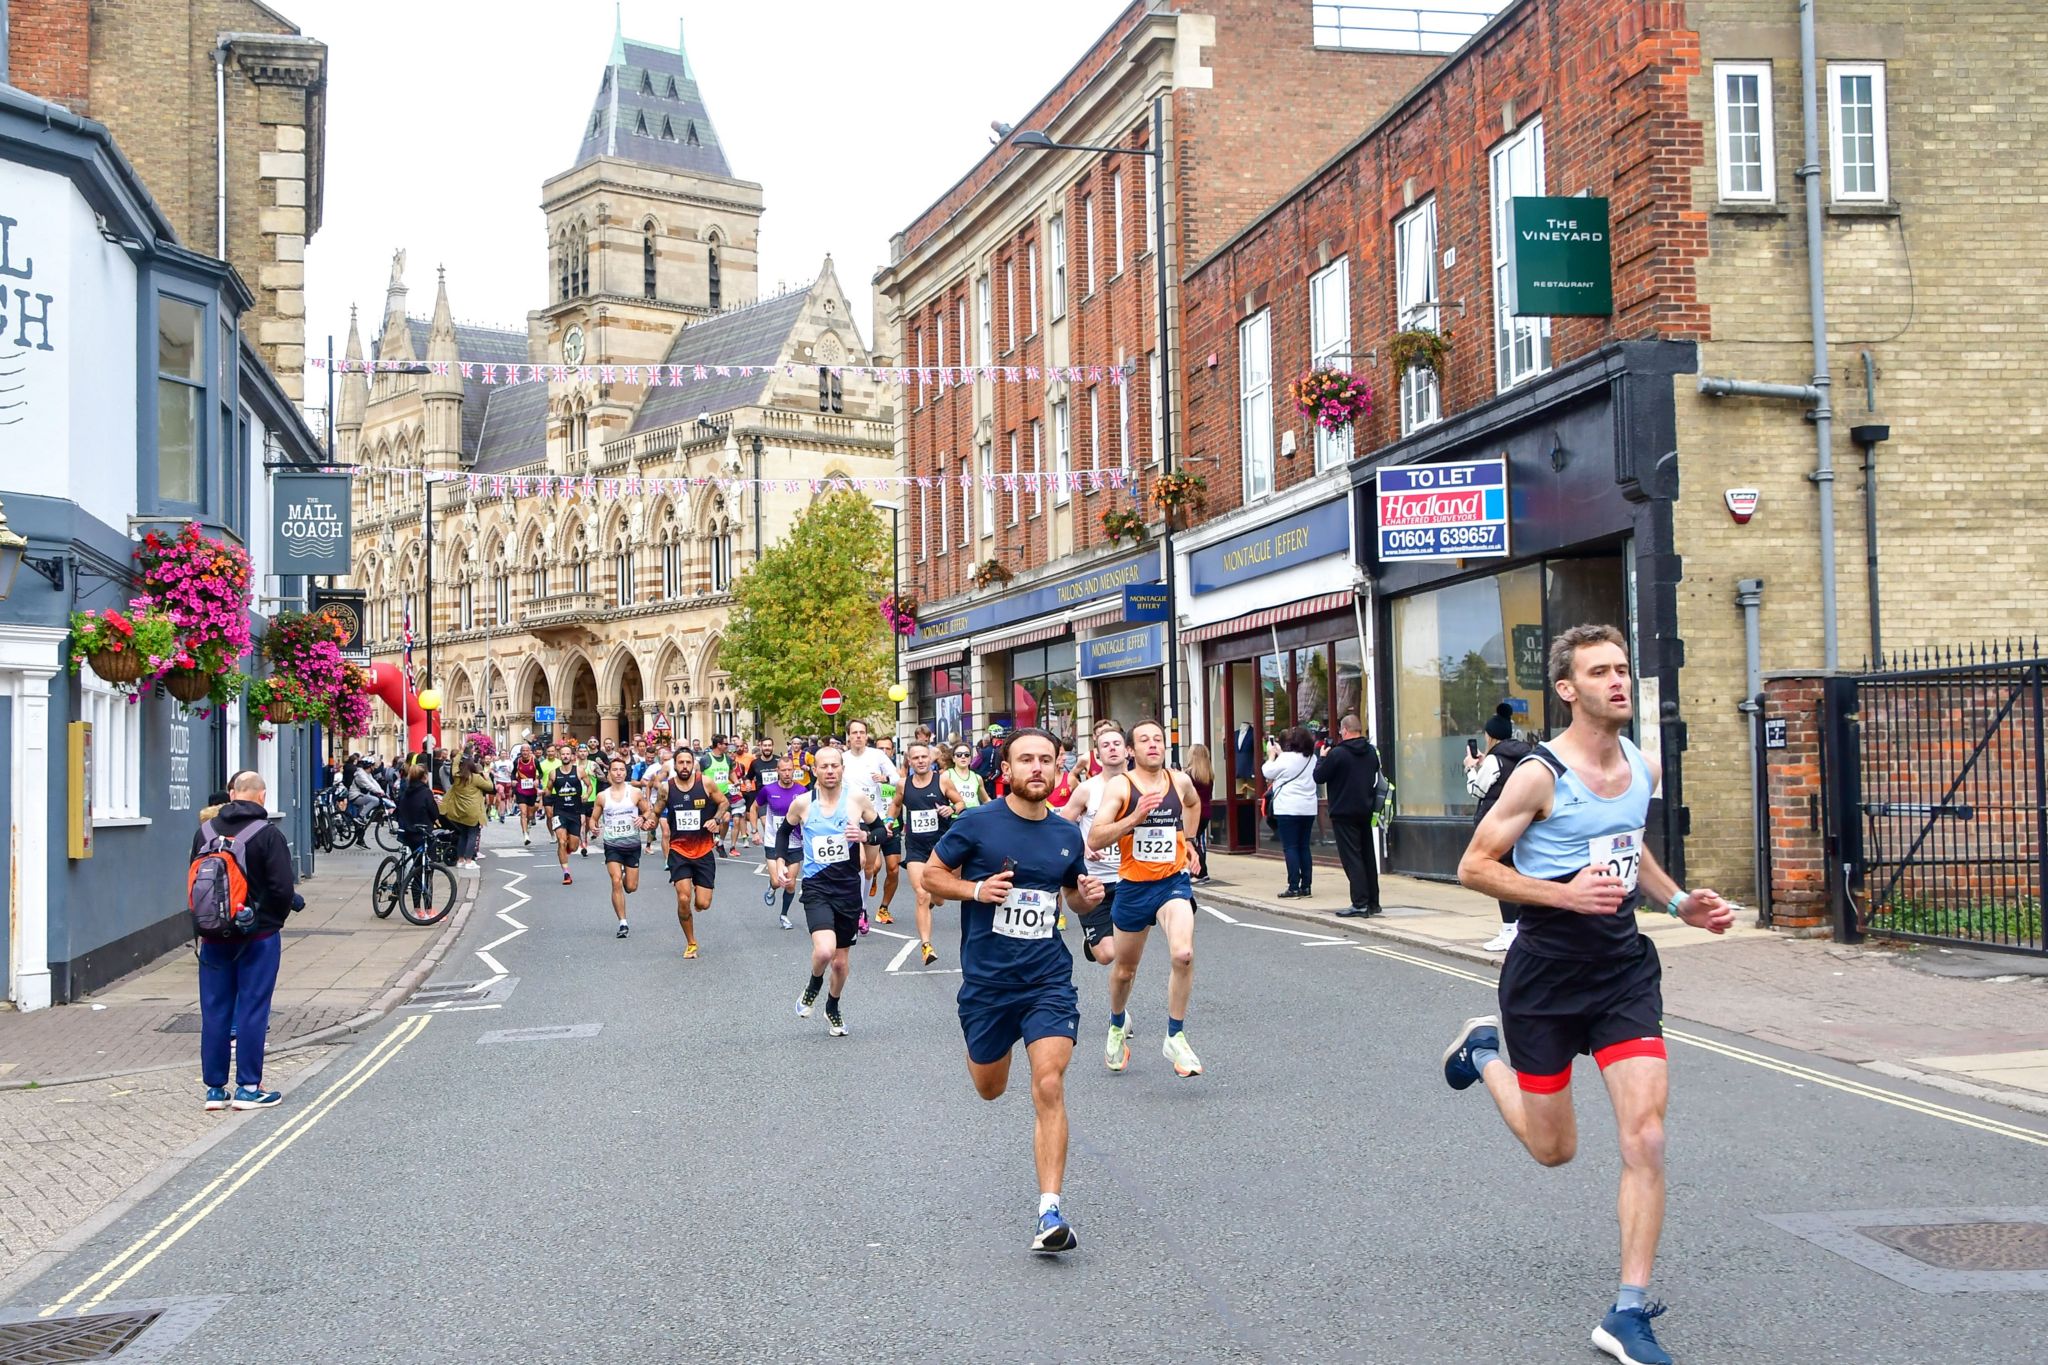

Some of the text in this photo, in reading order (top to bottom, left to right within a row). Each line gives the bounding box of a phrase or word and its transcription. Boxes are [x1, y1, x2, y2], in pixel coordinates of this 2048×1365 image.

[1546, 219, 1578, 229] THE
[1522, 231, 1603, 242] VINEYARD
[1407, 467, 1476, 488] TO LET
[288, 504, 337, 520] MAIL
[1386, 493, 1480, 519] Hadland
[1386, 513, 1477, 526] CHARTERED SURVEYORS
[281, 521, 343, 538] COACH
[1389, 526, 1497, 549] 01604 639657
[1223, 525, 1309, 573] MONTAGUE JEFFERY
[1058, 564, 1139, 603] TAILORS AND MENSWEAR
[921, 620, 949, 640] MONTAGUE
[1091, 631, 1149, 658] MONTAGUE JEFFERY
[677, 818, 699, 826] 1526
[913, 817, 937, 828] 1238
[818, 844, 844, 857] 662
[1136, 840, 1173, 853] 1322
[1004, 906, 1046, 927] 1101
